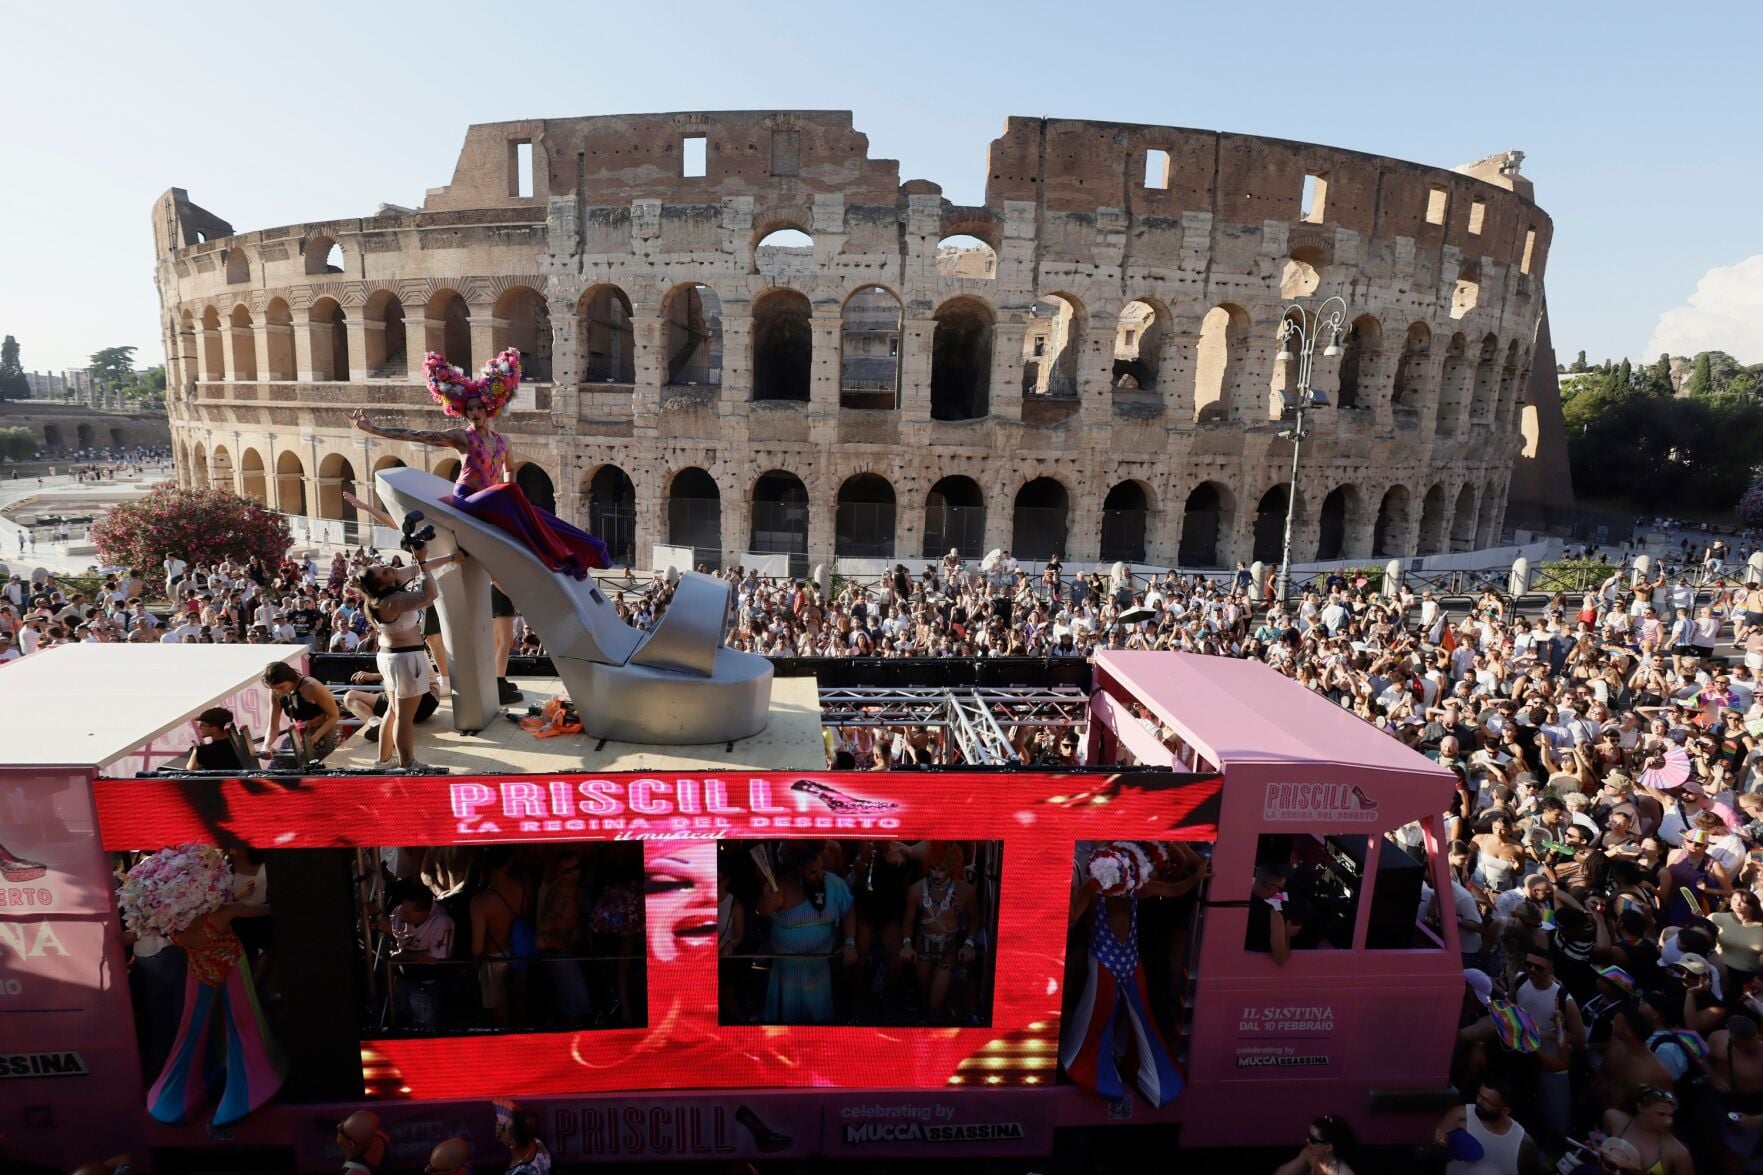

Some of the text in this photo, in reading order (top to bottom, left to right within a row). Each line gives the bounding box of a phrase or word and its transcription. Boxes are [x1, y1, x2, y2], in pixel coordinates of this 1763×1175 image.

[456, 816, 900, 833] LA REGINA DEL DESERTO
[1242, 1005, 1334, 1020] IL SISTINA
[1240, 1021, 1334, 1031] DAL 10 FEBBRAIO
[1236, 1046, 1295, 1056] celebrating by
[841, 1104, 955, 1121] celebrating by
